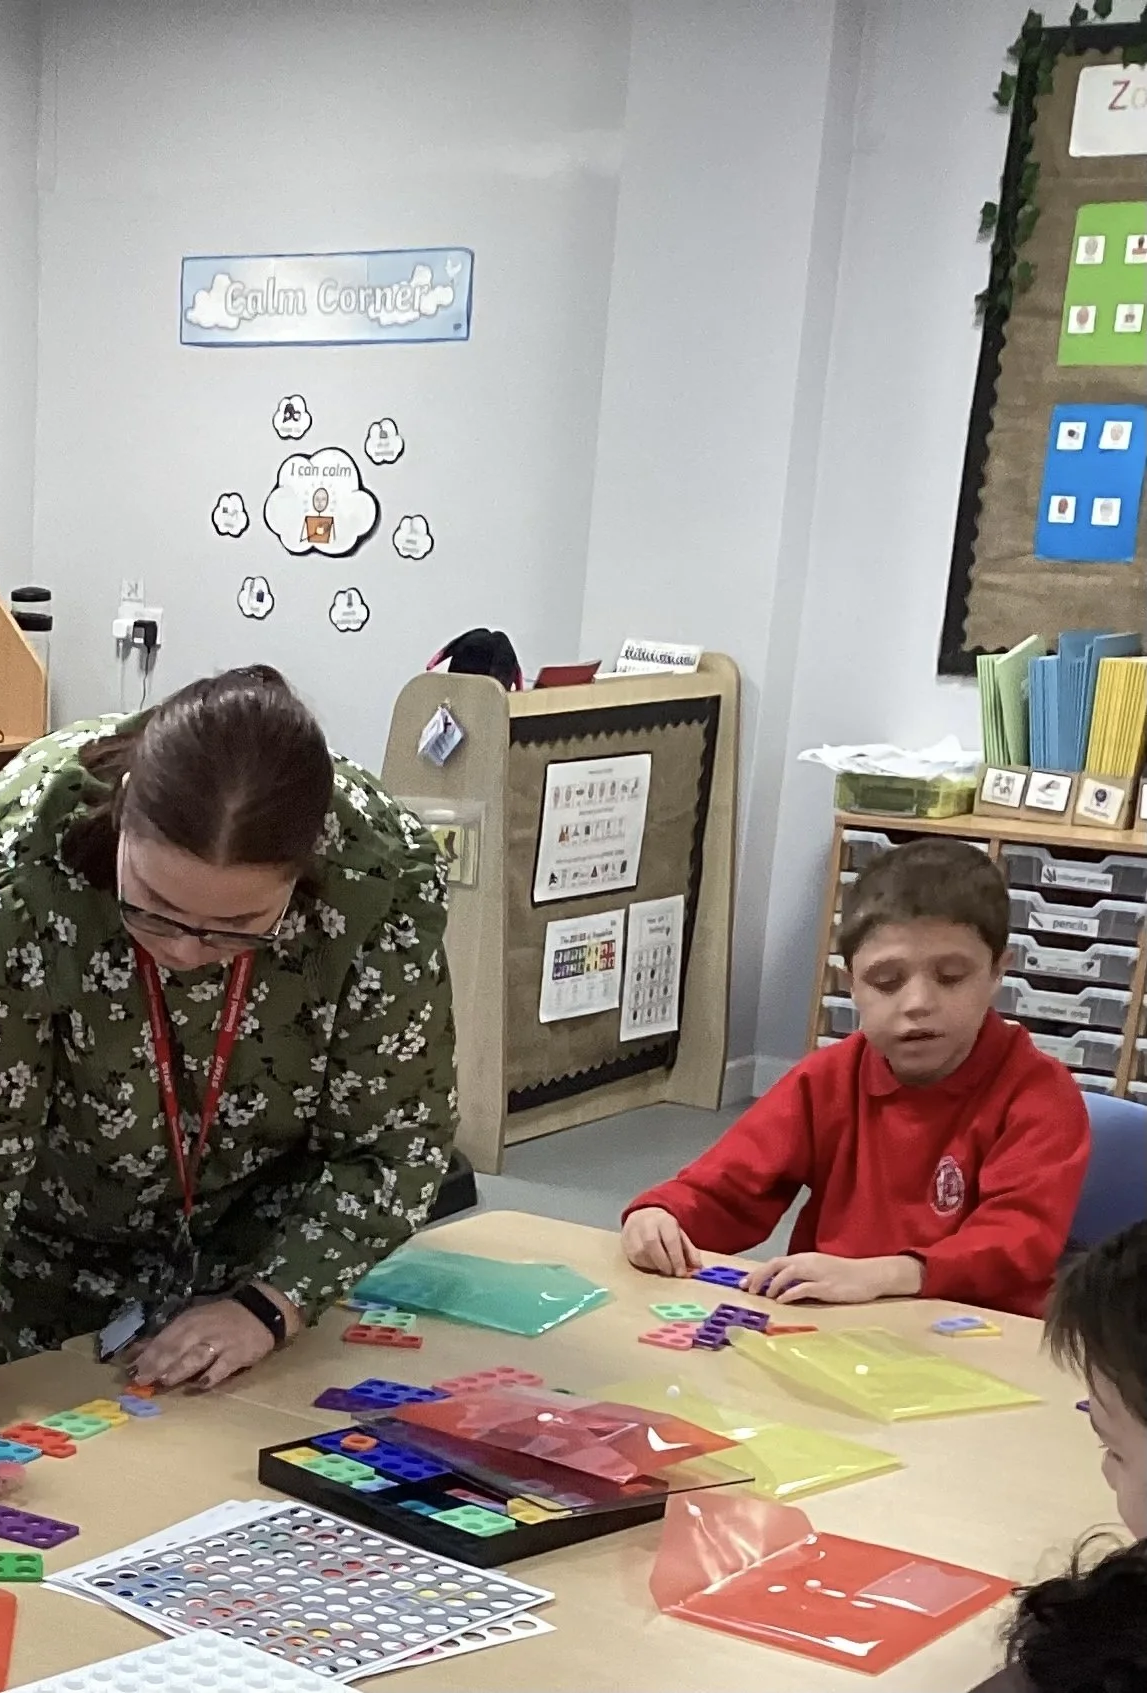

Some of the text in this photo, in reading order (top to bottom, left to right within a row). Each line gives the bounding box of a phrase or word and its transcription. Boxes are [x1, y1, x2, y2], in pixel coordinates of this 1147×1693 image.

[224, 276, 431, 316] Calm Corner
[290, 462, 352, 478] I can calm
[1052, 918, 1089, 932] pencils
